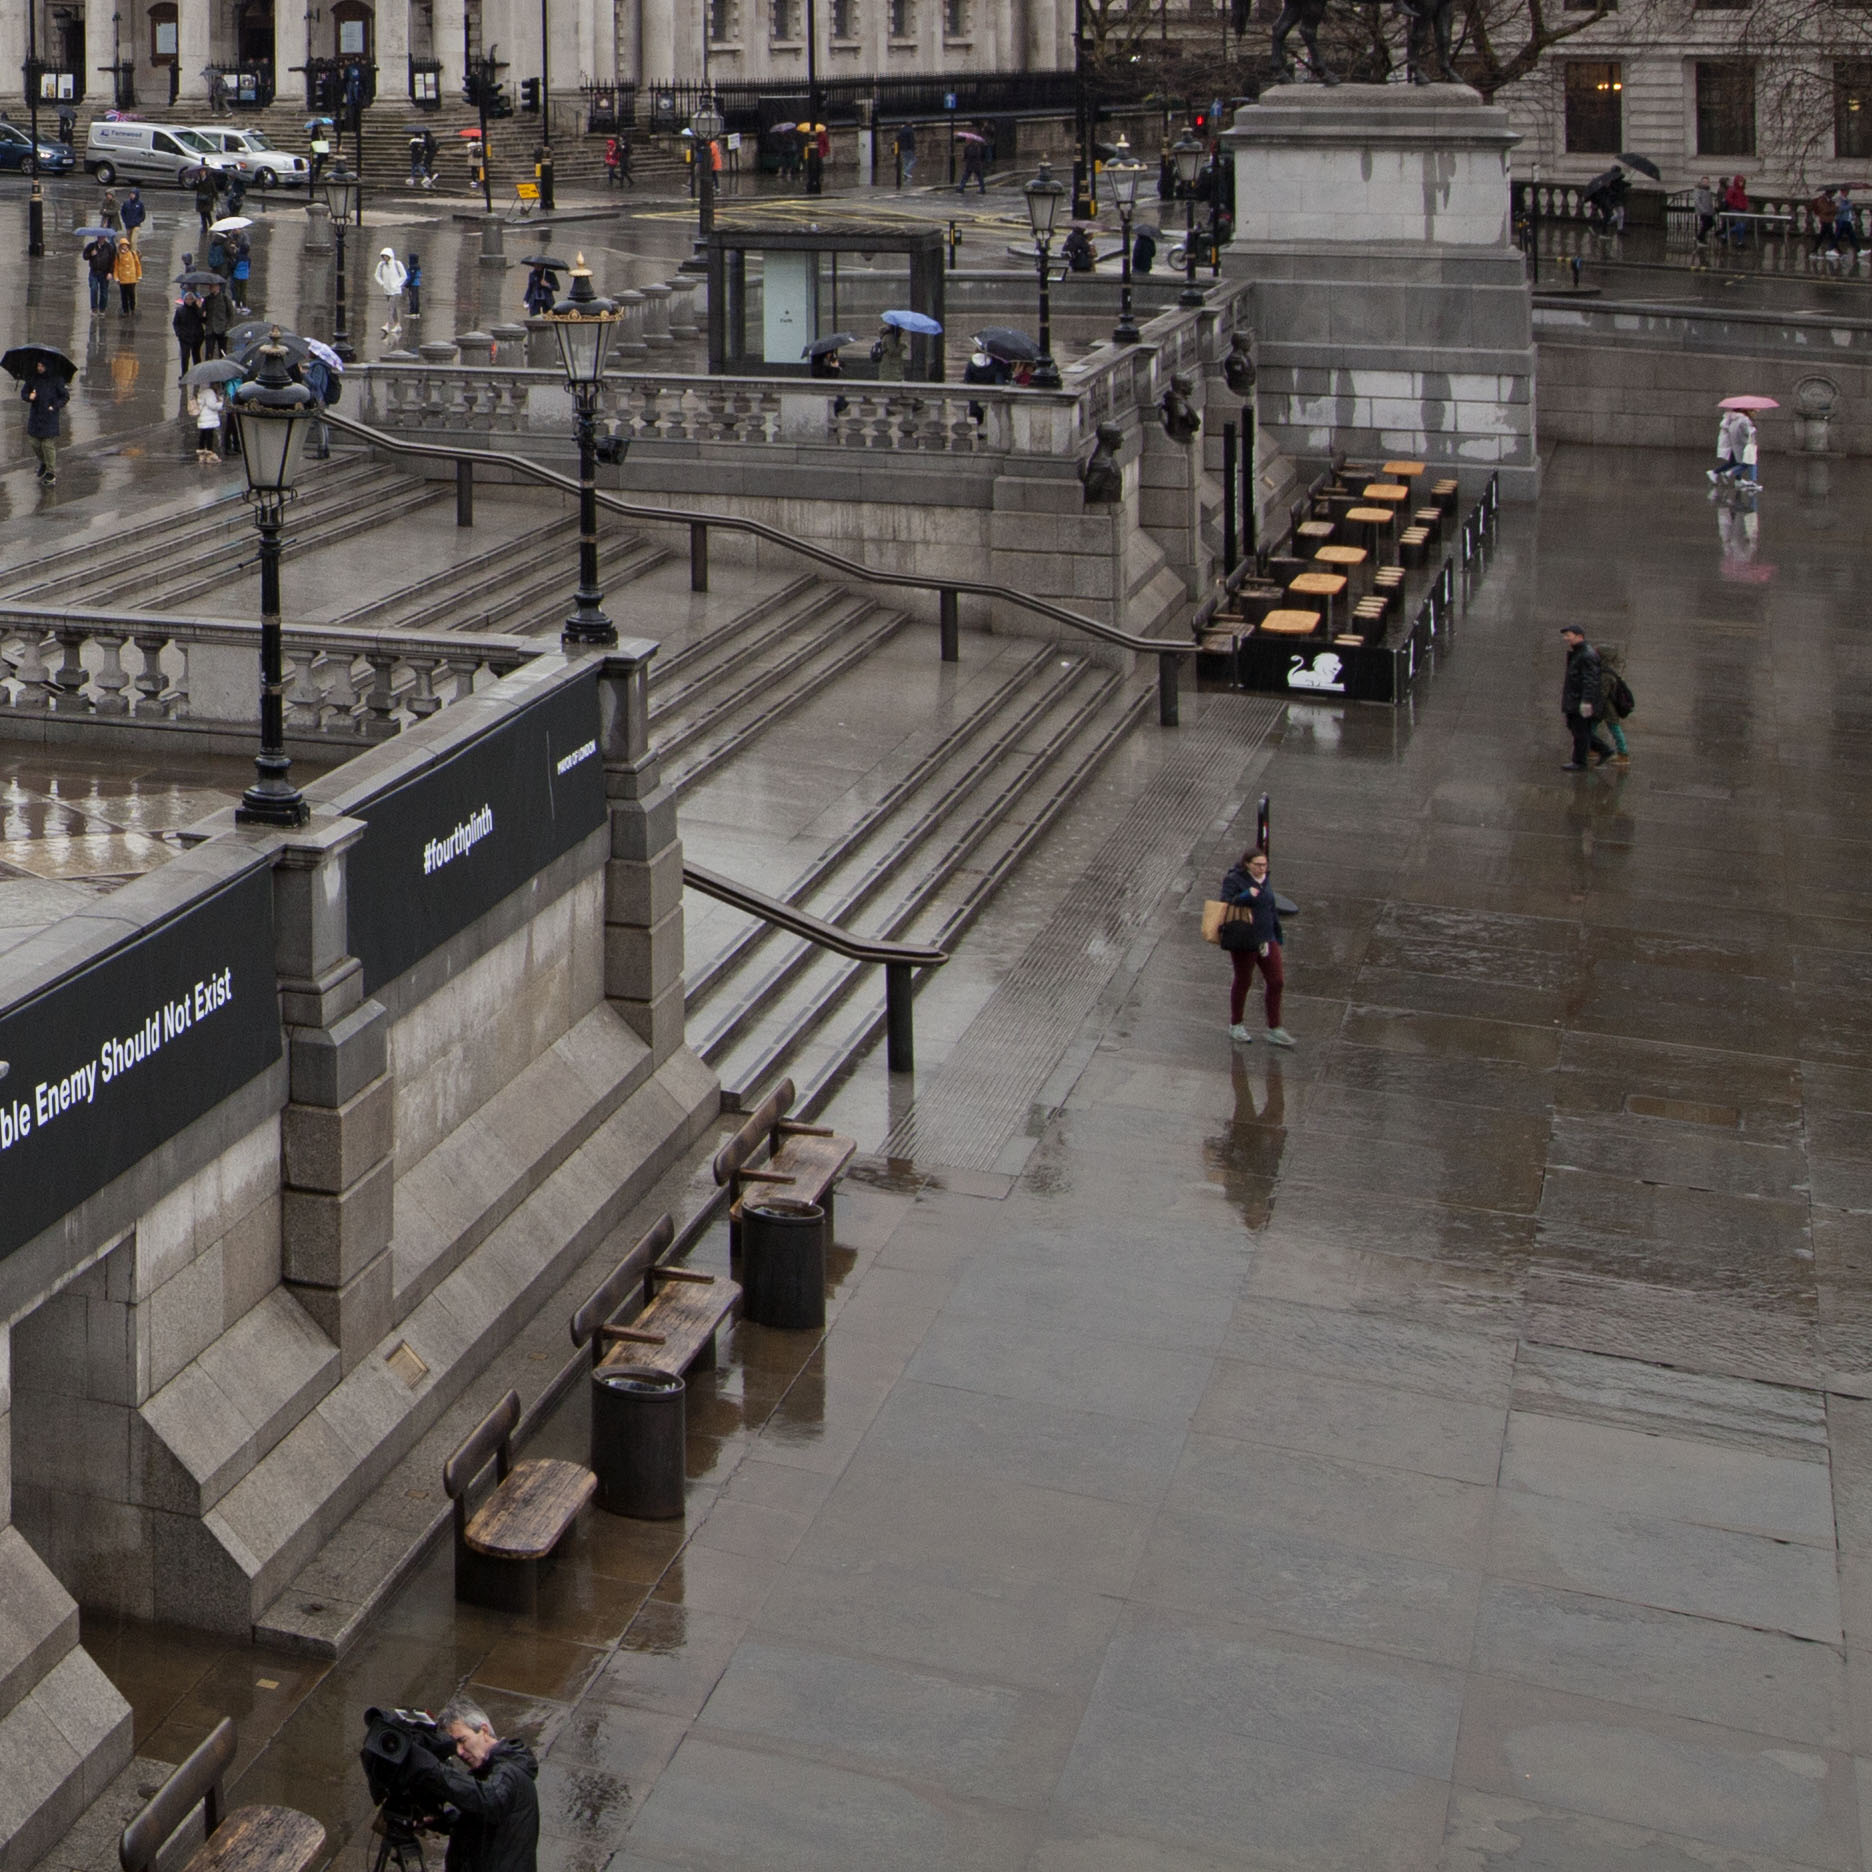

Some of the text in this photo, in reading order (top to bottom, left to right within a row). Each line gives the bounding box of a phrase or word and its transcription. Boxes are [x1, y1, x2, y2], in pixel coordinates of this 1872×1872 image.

[577, 738, 597, 762] LONDON
[423, 802, 494, 876] #fourthplinth
[35, 1059, 98, 1128] Enemy
[101, 1011, 162, 1084] Should
[163, 993, 193, 1043] Not
[194, 966, 233, 1022] Exist
